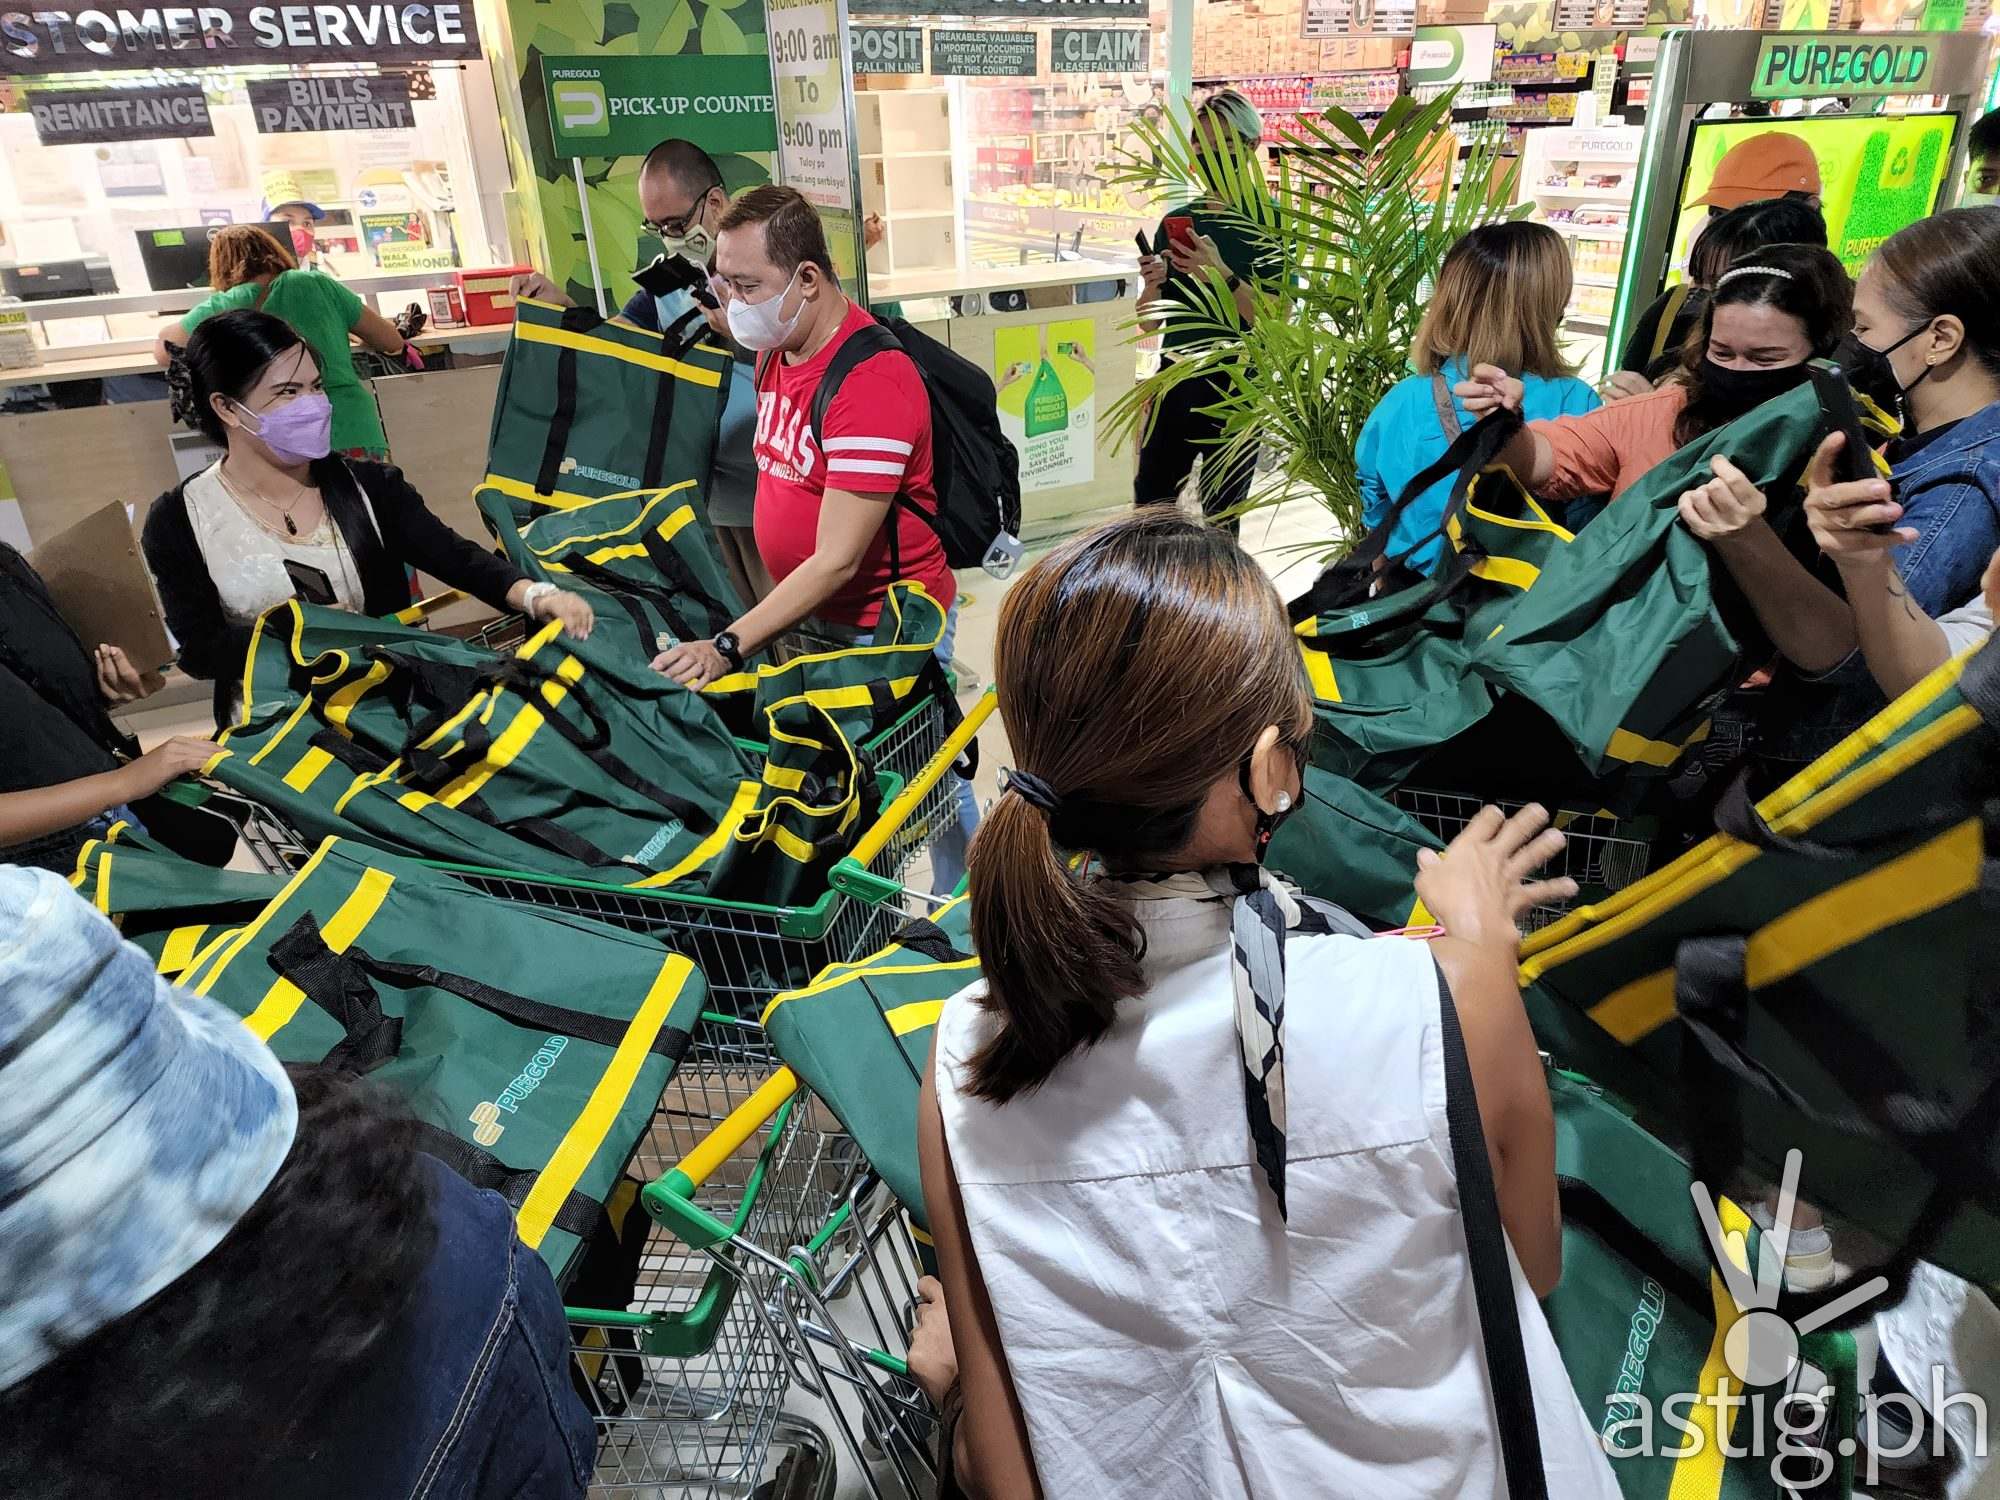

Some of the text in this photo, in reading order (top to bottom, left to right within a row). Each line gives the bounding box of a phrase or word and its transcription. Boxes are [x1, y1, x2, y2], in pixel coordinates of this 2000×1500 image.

[249, 4, 466, 48] SERVICE
[989, 33, 1034, 43] VALUABLES
[775, 28, 838, 63] 9:00 am
[941, 43, 986, 53] IMPORTANT
[988, 44, 1034, 53] DOCUMENTS
[1063, 31, 1142, 61] CLAIM
[856, 62, 920, 72] FALL IN LINE
[947, 55, 1022, 64] ARE NOT ACCEPTED
[951, 66, 1019, 75] AT THIS COUNTER
[1055, 62, 1148, 72] PLEASE FALL IN LINE
[1766, 44, 1928, 86] PUREGOLD
[552, 69, 601, 78] PUREGOLD
[288, 78, 372, 105] BILLS
[795, 76, 819, 103] To
[32, 97, 209, 132] REMITTANCE
[261, 103, 405, 133] PAYMENT
[609, 95, 774, 115] PICK-UP COUNTE
[783, 122, 842, 154] 9:00 pm
[1844, 236, 1889, 256] PURE
[753, 392, 815, 477] UESS
[574, 464, 641, 489] PUREGOLD
[1021, 457, 1072, 478] ENVIRONMENT
[495, 1035, 568, 1114] PUREGOLD
